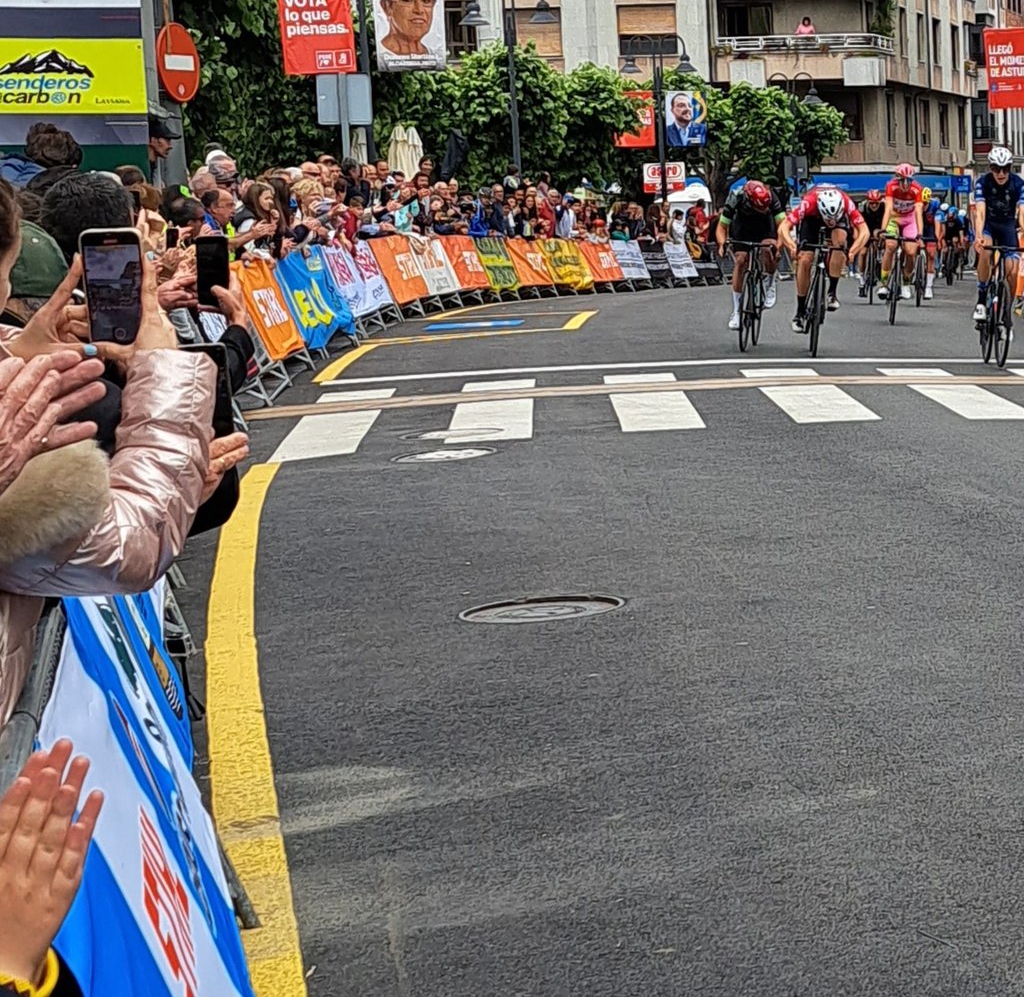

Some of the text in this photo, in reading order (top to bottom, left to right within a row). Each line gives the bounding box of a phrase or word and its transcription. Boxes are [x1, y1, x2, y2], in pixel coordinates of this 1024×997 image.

[285, 8, 331, 23] lo que
[286, 22, 350, 38] piensas.
[989, 56, 999, 66] EL
[991, 67, 1001, 78] DE
